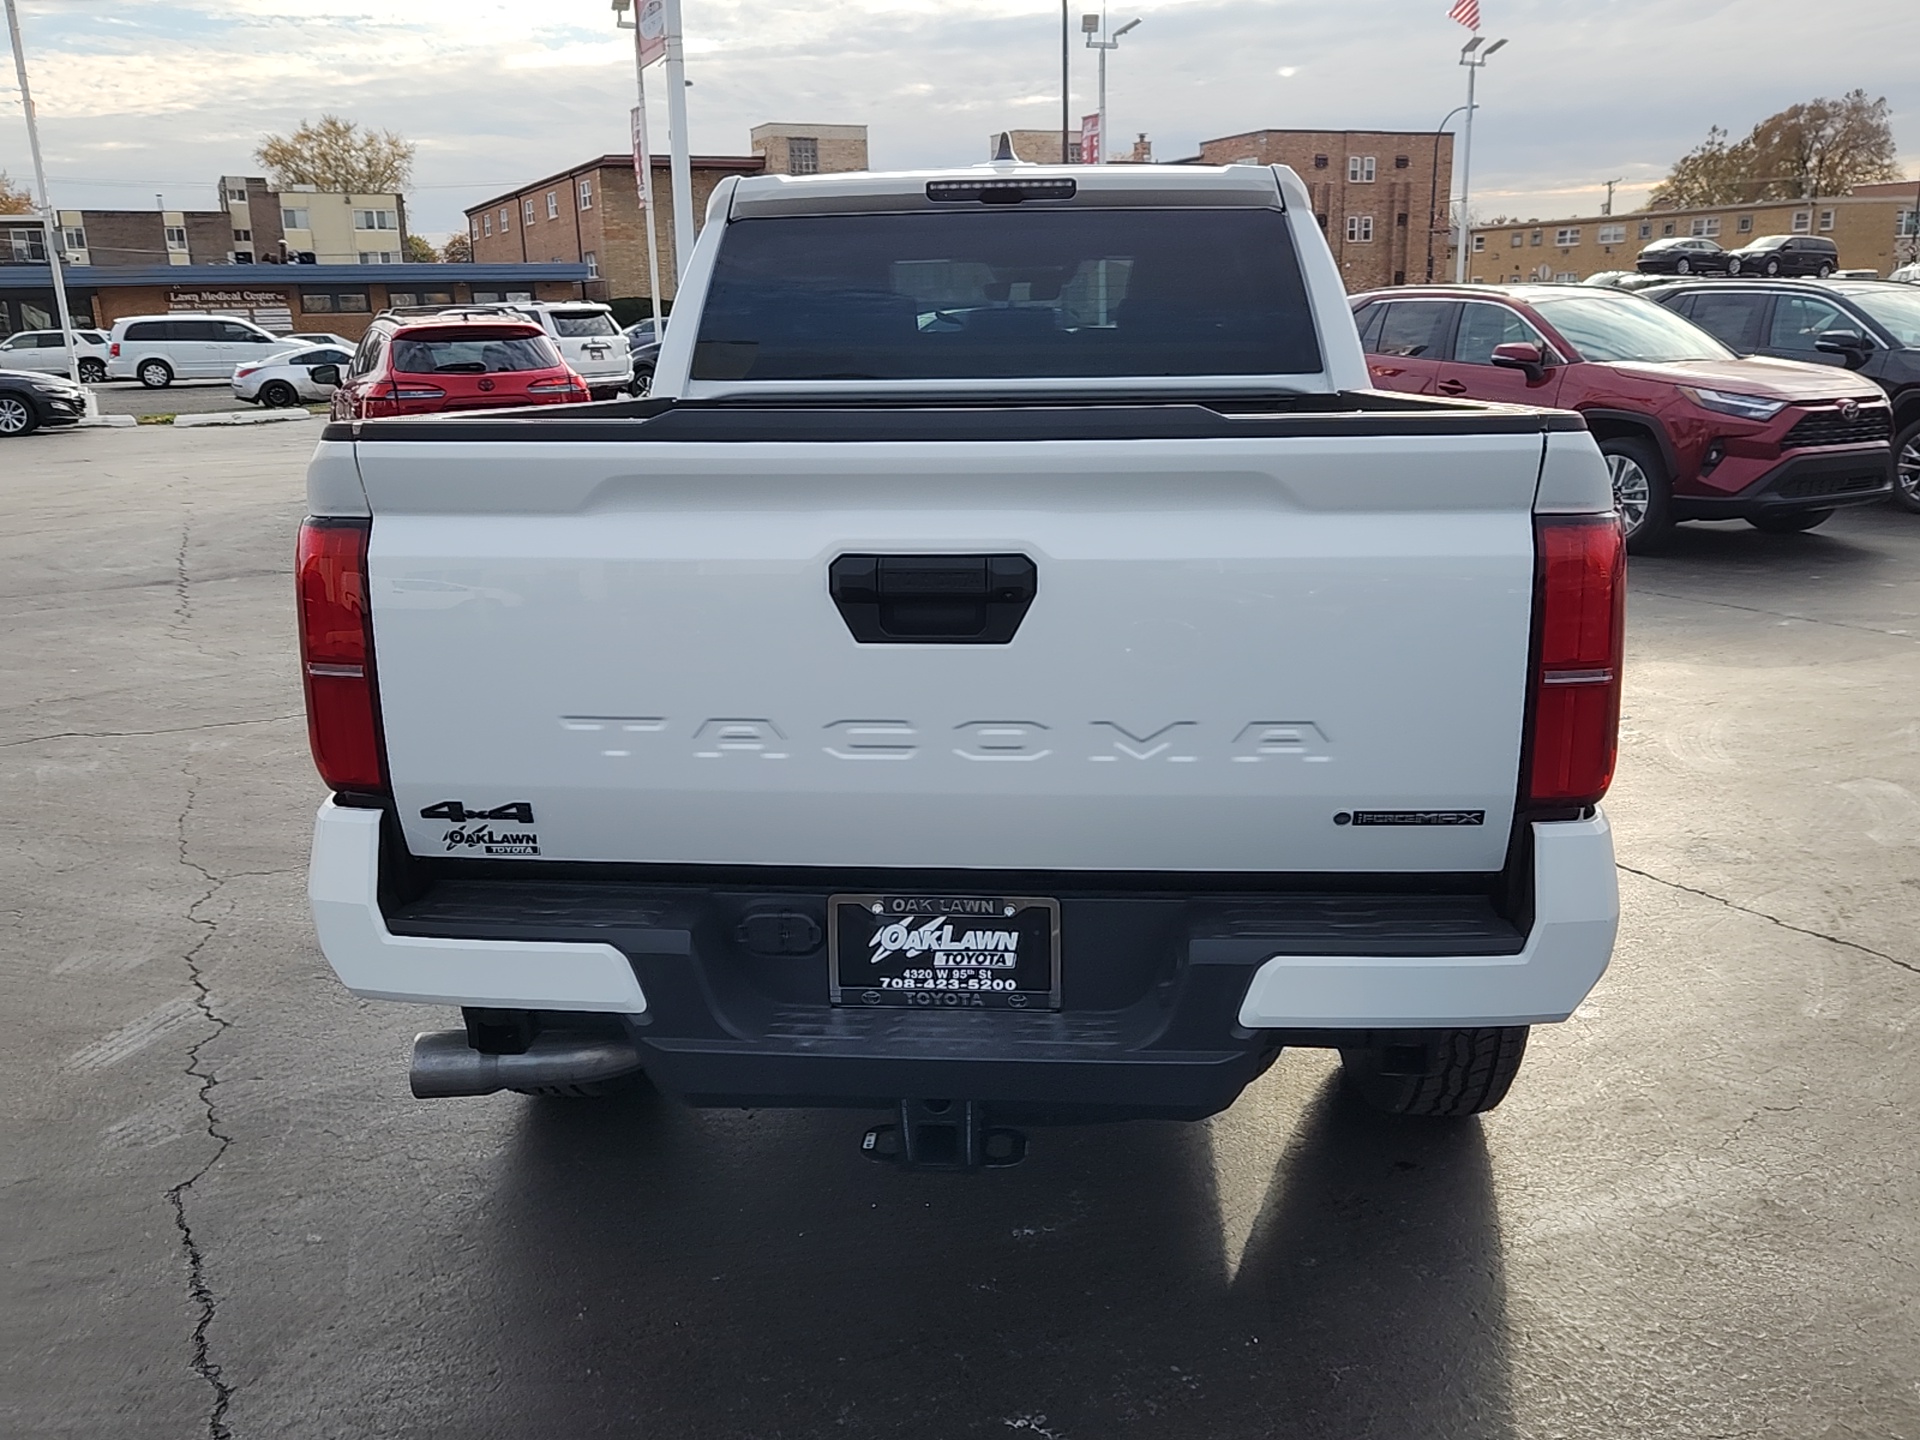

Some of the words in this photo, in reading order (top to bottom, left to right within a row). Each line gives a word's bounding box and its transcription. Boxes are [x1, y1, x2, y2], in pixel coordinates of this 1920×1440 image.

[170, 292, 200, 303] Lawn
[201, 291, 241, 301] Medical
[243, 291, 276, 302] Center
[558, 715, 1333, 763] TACOMA
[490, 846, 534, 854] TOYOTA
[892, 898, 933, 913] OAK
[939, 899, 995, 914] LAWN
[942, 952, 1008, 966] TOYOTA
[903, 969, 933, 979] 4320
[936, 970, 948, 979] W
[952, 969, 975, 980] 95th
[979, 970, 992, 980] St
[879, 977, 1017, 991] 708-423-5200
[903, 992, 984, 1005] TOYOTA
